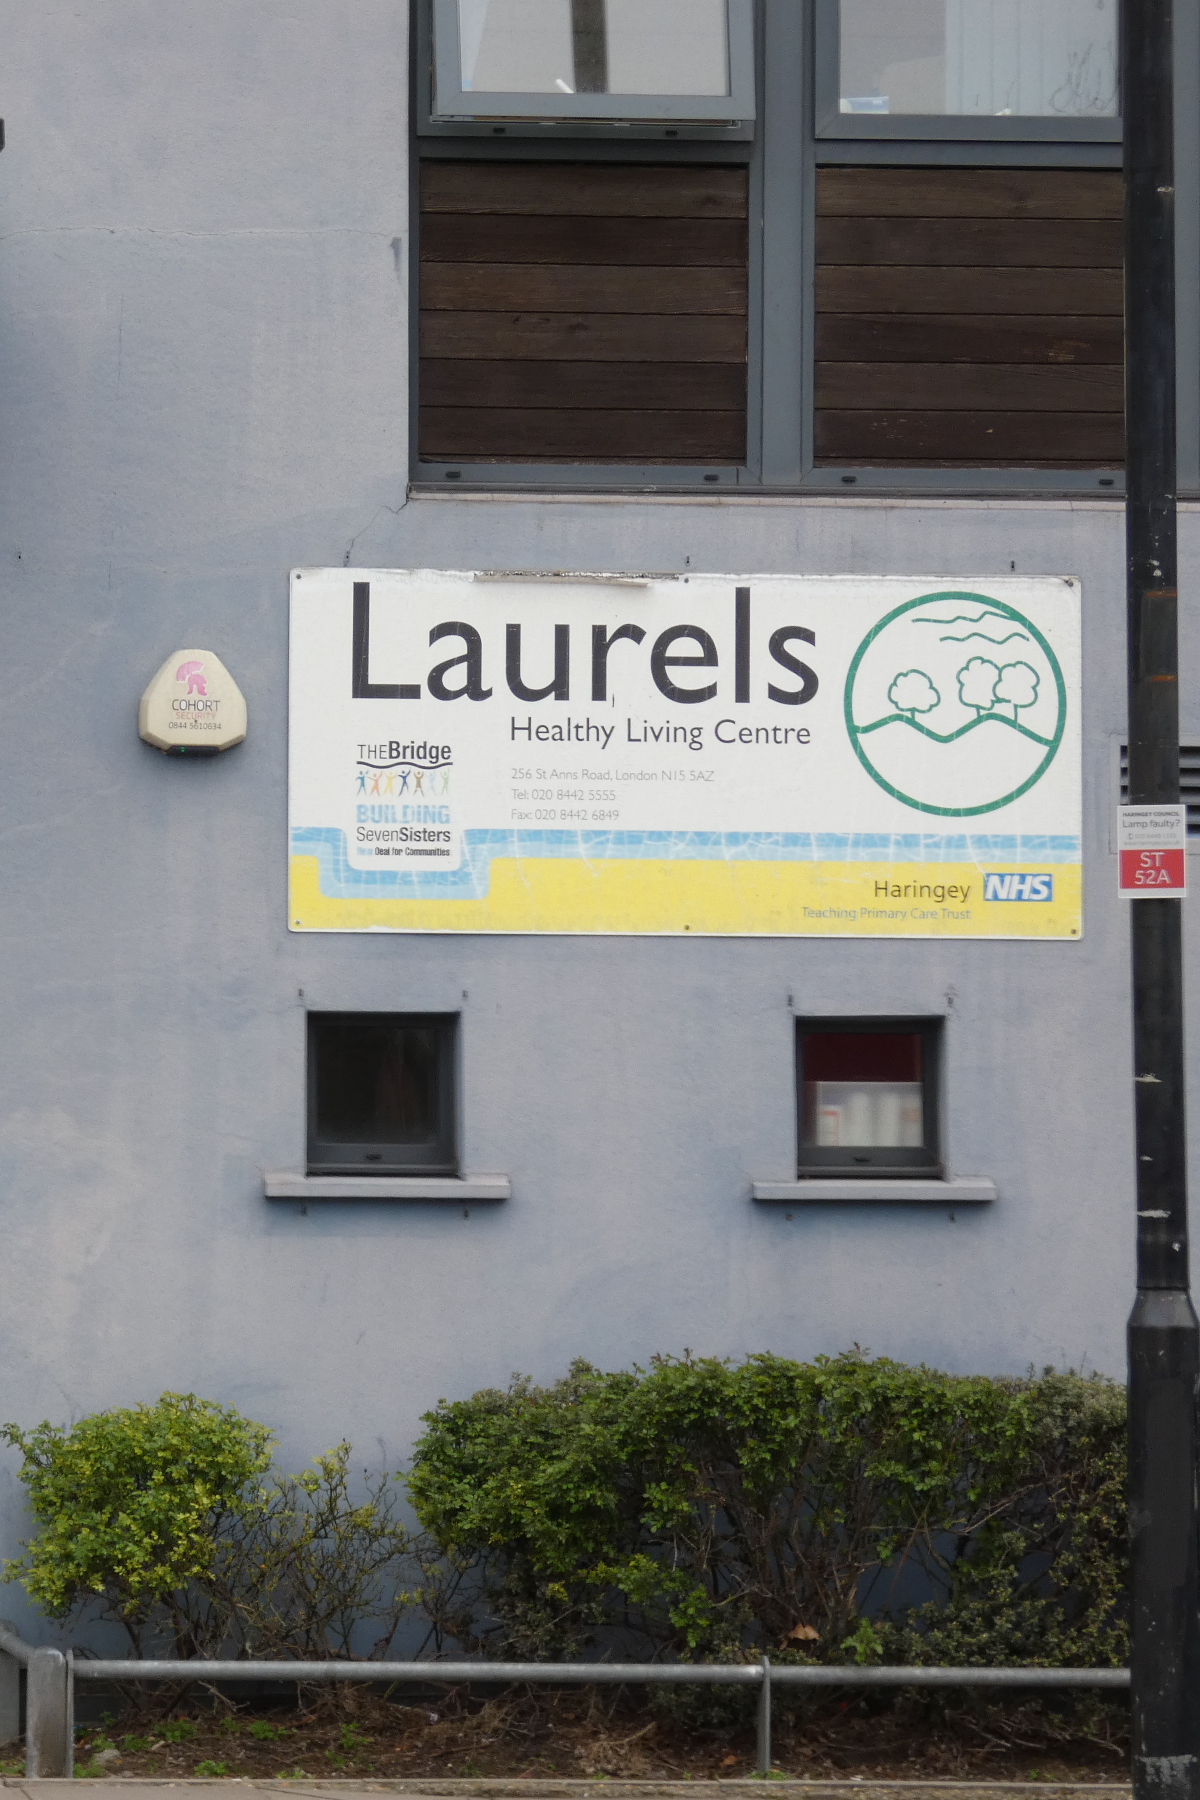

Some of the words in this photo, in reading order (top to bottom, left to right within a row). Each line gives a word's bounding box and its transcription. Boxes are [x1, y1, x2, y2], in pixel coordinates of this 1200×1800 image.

[352, 582, 819, 706] Laurels
[172, 699, 220, 711] COHORT
[176, 712, 217, 720] SECURITY
[511, 717, 614, 749] Healthy
[628, 718, 703, 751] Living
[715, 719, 810, 744] Centre
[512, 768, 532, 779] 256
[536, 768, 547, 779] St
[550, 769, 578, 780] Anns
[582, 769, 612, 781] Road,
[616, 770, 657, 780] London
[662, 770, 685, 781] N15
[690, 770, 714, 781] 5AZ
[511, 789, 529, 800] Tel:
[532, 789, 553, 800] 020
[557, 789, 584, 800] 8442
[589, 790, 616, 801] 5555
[356, 804, 451, 825] BUILDING
[511, 809, 532, 820] Fax:
[535, 809, 556, 820] 020
[560, 809, 587, 820] 8442
[592, 810, 619, 820] 6849
[1122, 820, 1147, 828] Lamp
[1149, 820, 1180, 829] faulty?
[374, 847, 391, 856] Deal
[391, 847, 404, 856] for
[404, 847, 451, 857] Communities
[1140, 852, 1164, 867] ST
[1134, 869, 1172, 885] 52A
[873, 880, 971, 903] Haringey
[984, 875, 1051, 900] NHS
[802, 907, 857, 921] Teaching
[860, 908, 907, 922] Primary
[910, 908, 939, 920] Care
[941, 909, 972, 921] Trust
